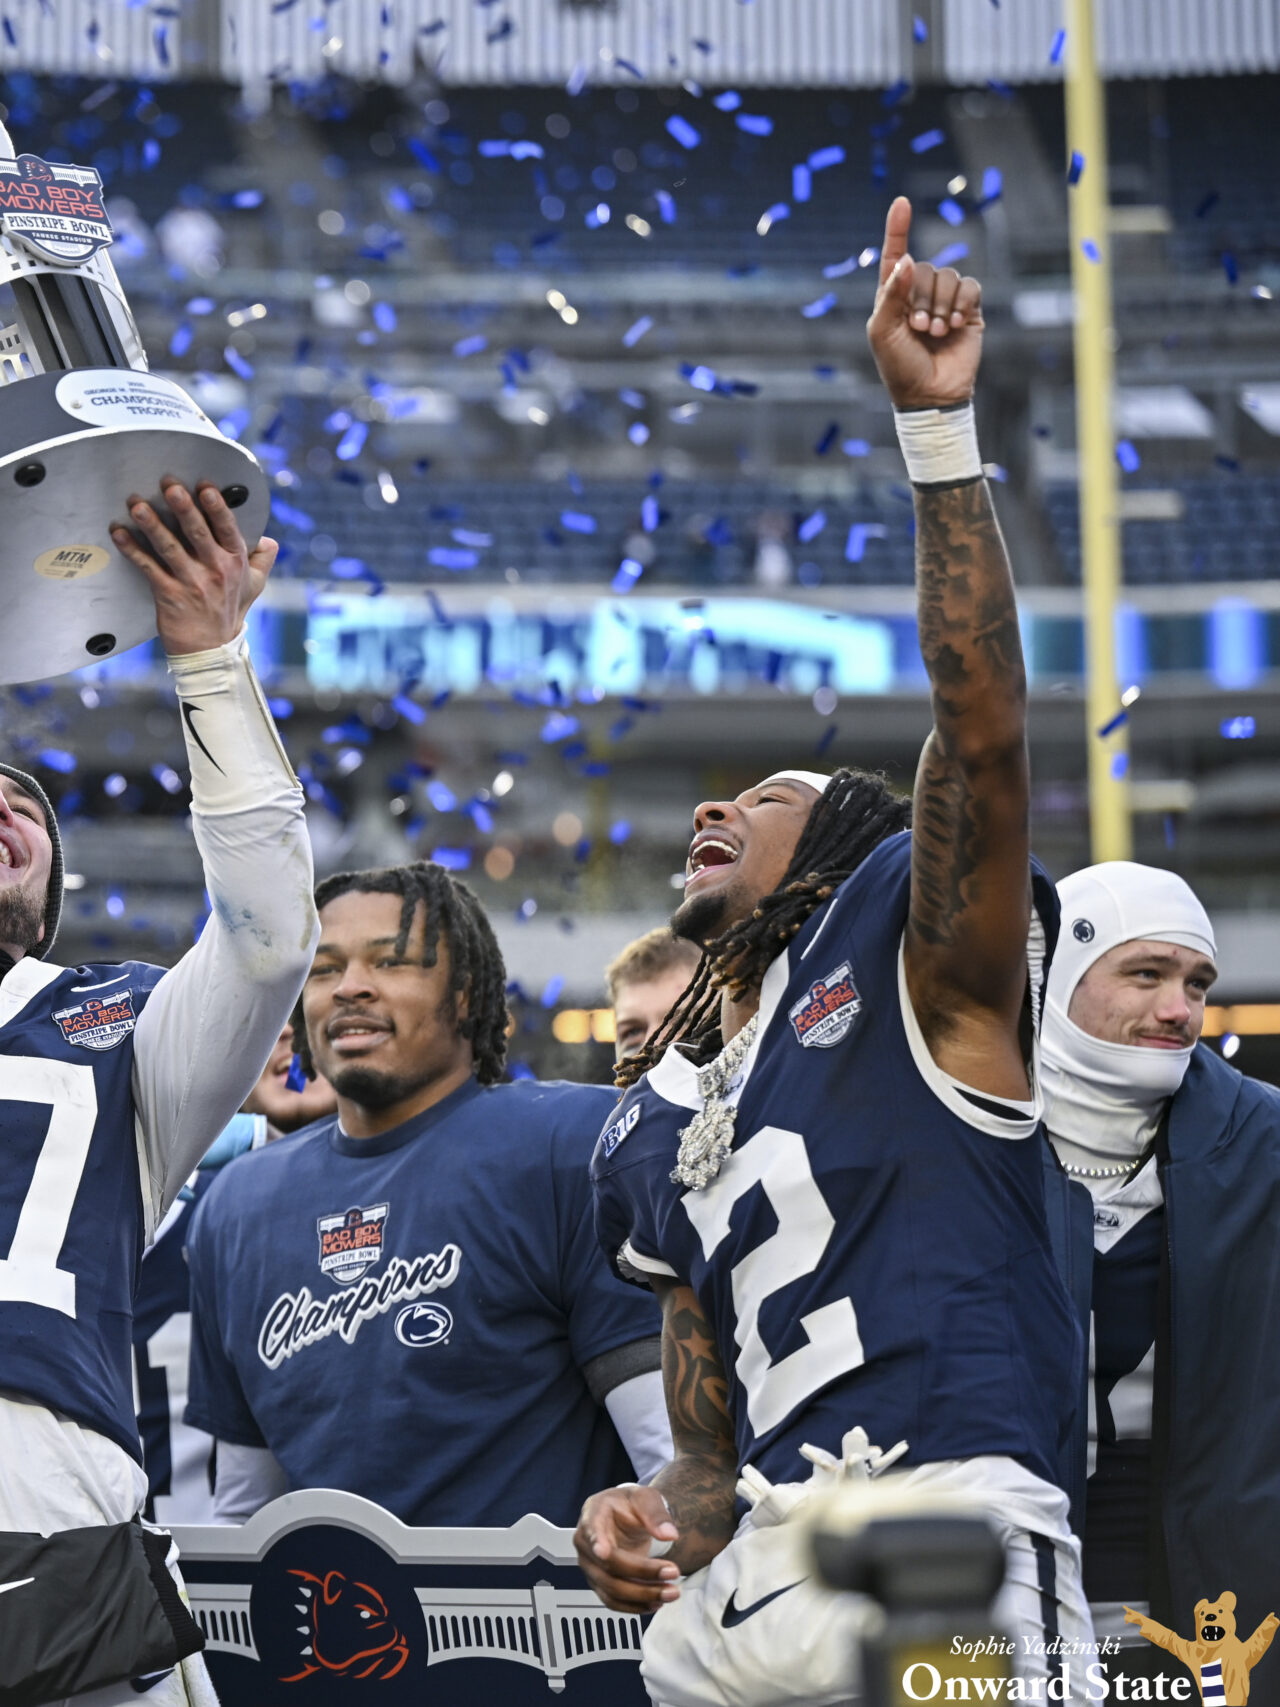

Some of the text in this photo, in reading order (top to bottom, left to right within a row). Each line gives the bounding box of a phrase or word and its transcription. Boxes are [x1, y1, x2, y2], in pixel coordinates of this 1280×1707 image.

[46, 186, 94, 202] BOY
[7, 215, 108, 238] PINSTRIPE BOWL
[55, 550, 93, 563] MTM
[62, 1002, 127, 1026] BAD BOY
[795, 981, 849, 1026] BAD BOY
[798, 989, 856, 1034] MOWERS
[64, 1009, 132, 1034] MOWERS
[70, 1027, 108, 1042] PINSTRIPE
[109, 1021, 133, 1032] BOWL
[322, 1232, 382, 1256] MOWERS
[323, 1222, 381, 1245] BAD BOY
[680, 1125, 865, 1439] 2
[258, 1243, 462, 1370] Champions
